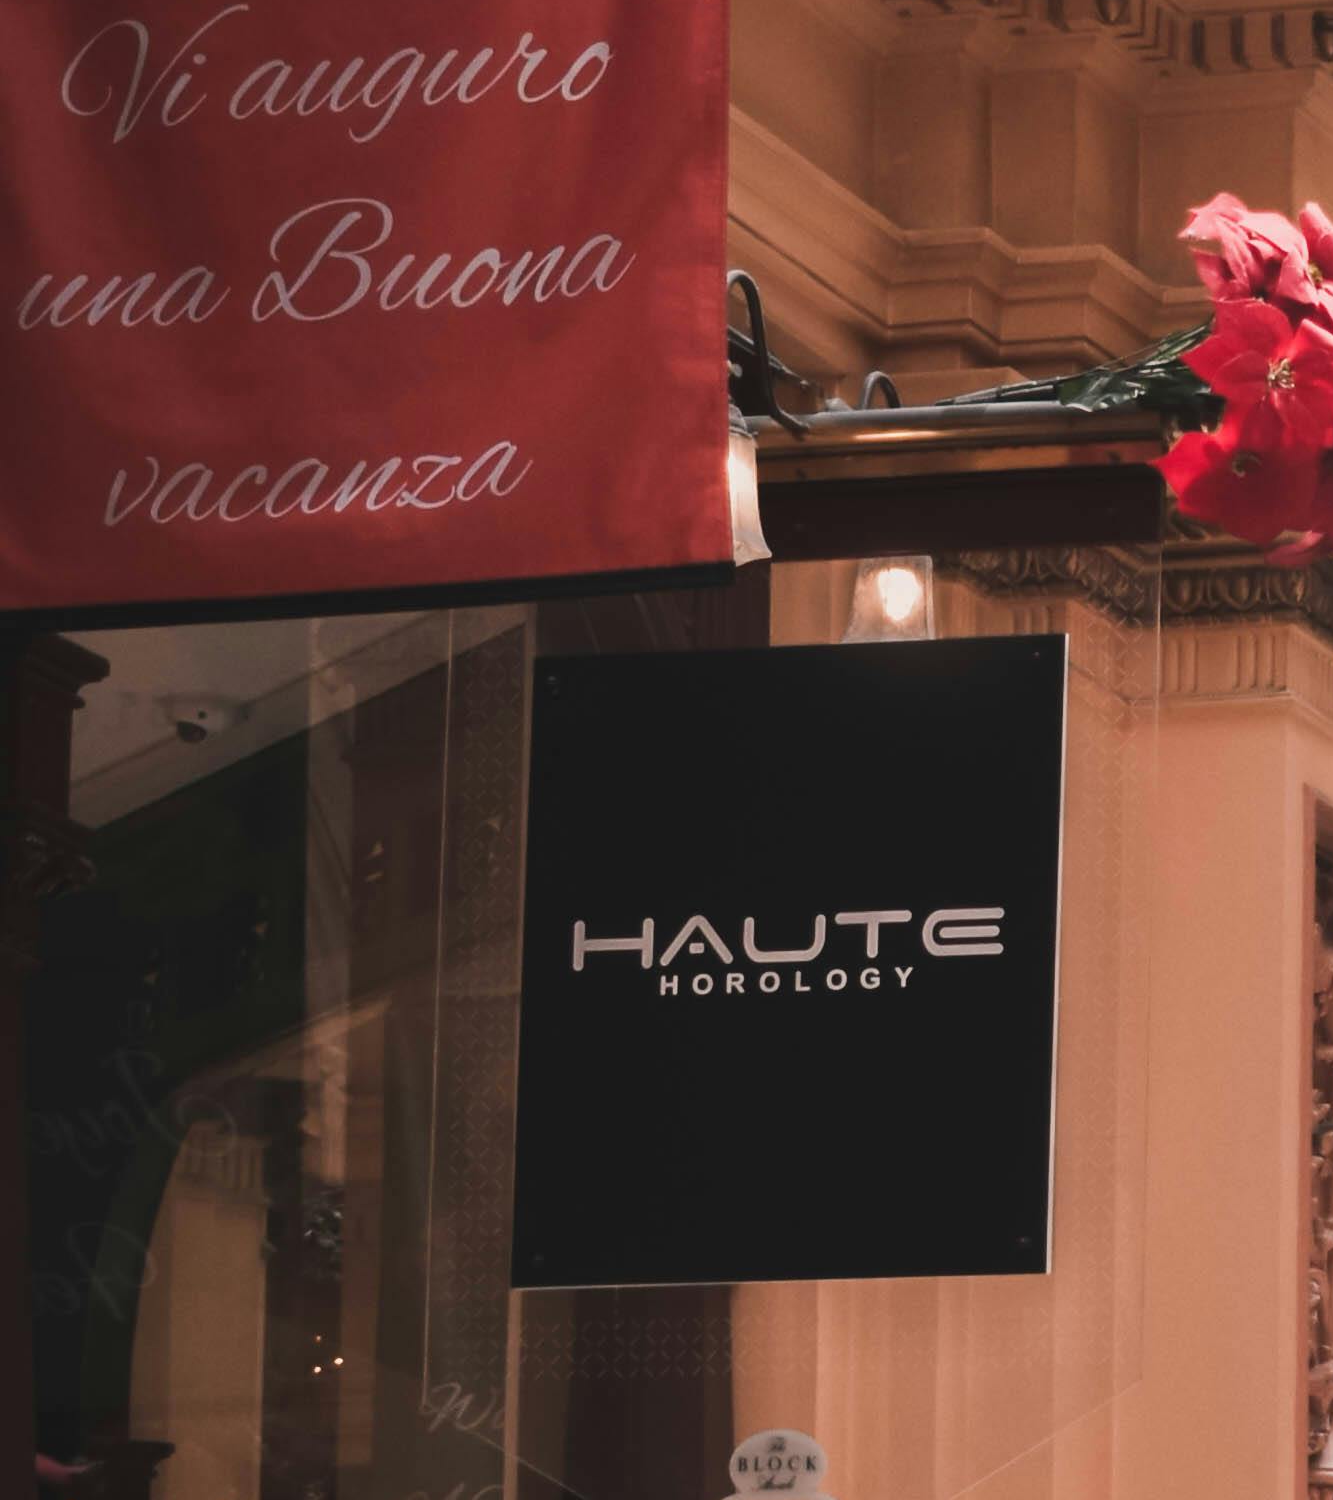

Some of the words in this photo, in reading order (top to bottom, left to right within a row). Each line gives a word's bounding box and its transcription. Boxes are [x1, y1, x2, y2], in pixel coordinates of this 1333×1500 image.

[61, 4, 249, 145] Vi
[228, 31, 616, 143] auguro
[17, 262, 231, 330] una
[251, 197, 636, 321] Buona
[103, 439, 533, 526] vacanza
[572, 907, 1005, 972] HAUTE
[659, 966, 915, 996] HOROLOGY
[738, 1455, 818, 1473] BLOCK
